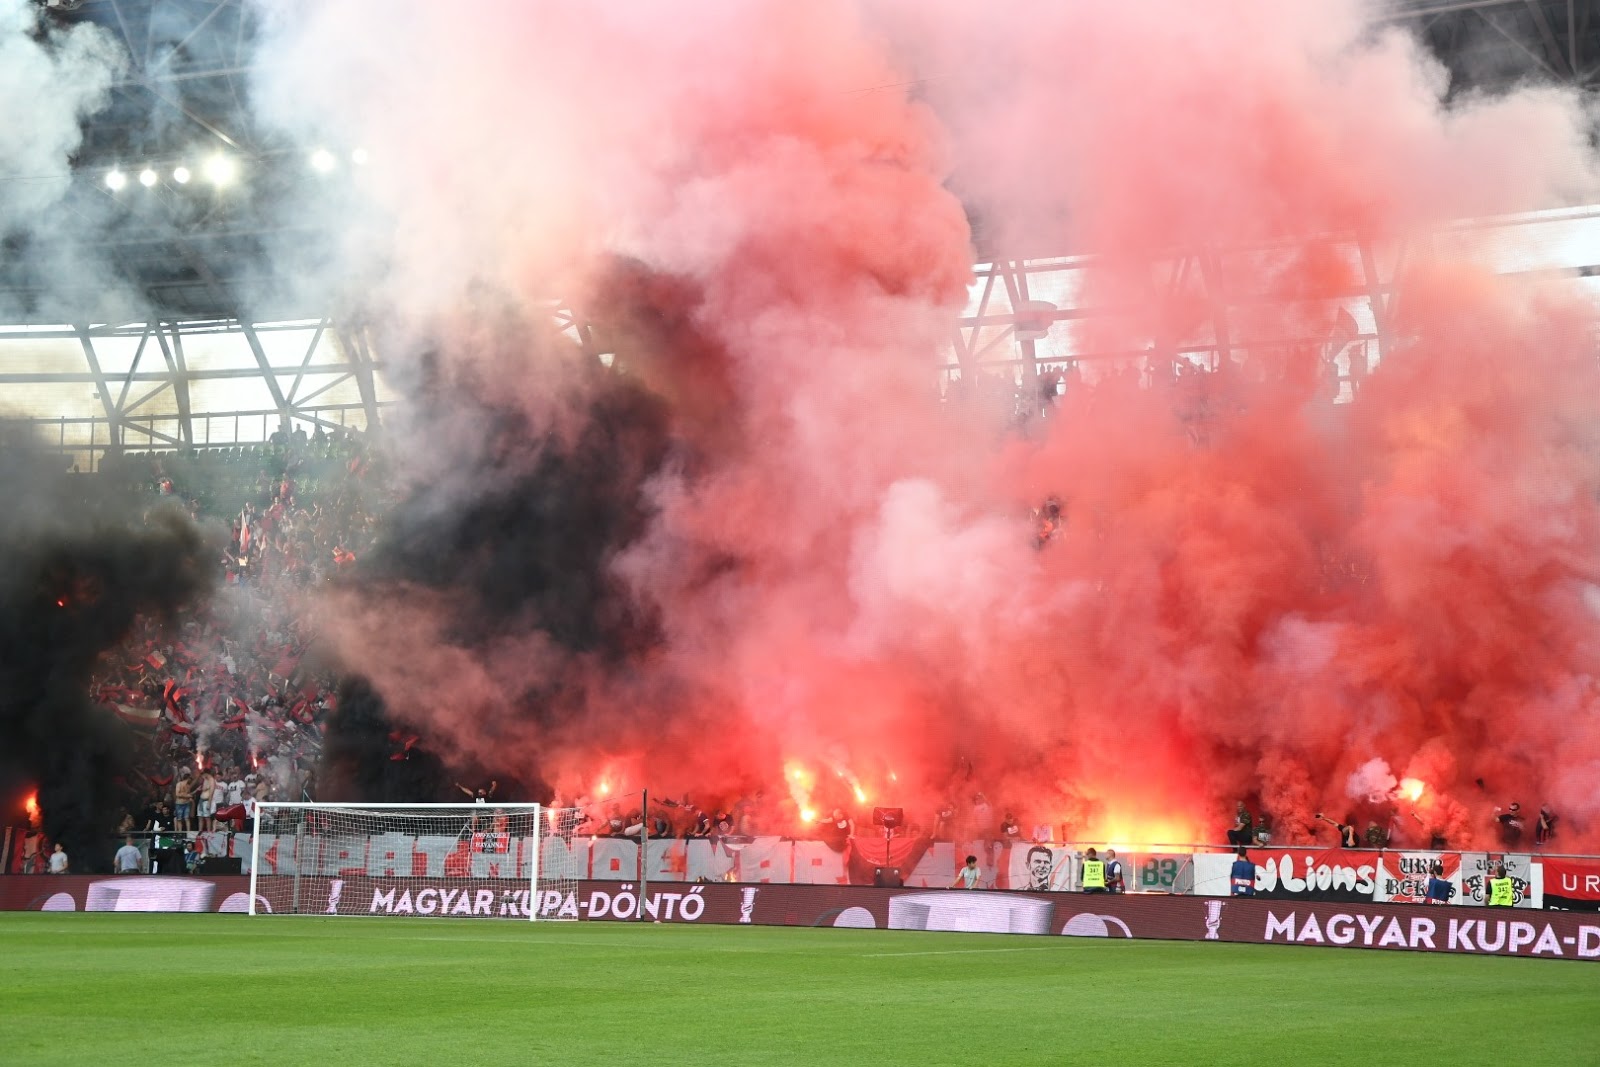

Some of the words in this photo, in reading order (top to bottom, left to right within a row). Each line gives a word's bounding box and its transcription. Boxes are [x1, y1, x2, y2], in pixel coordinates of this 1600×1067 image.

[1142, 857, 1178, 887] B3
[370, 887, 494, 915] MAGYAR
[500, 884, 705, 921] KUPA-DÖNTŐ
[1264, 910, 1436, 948] MAGYAR
